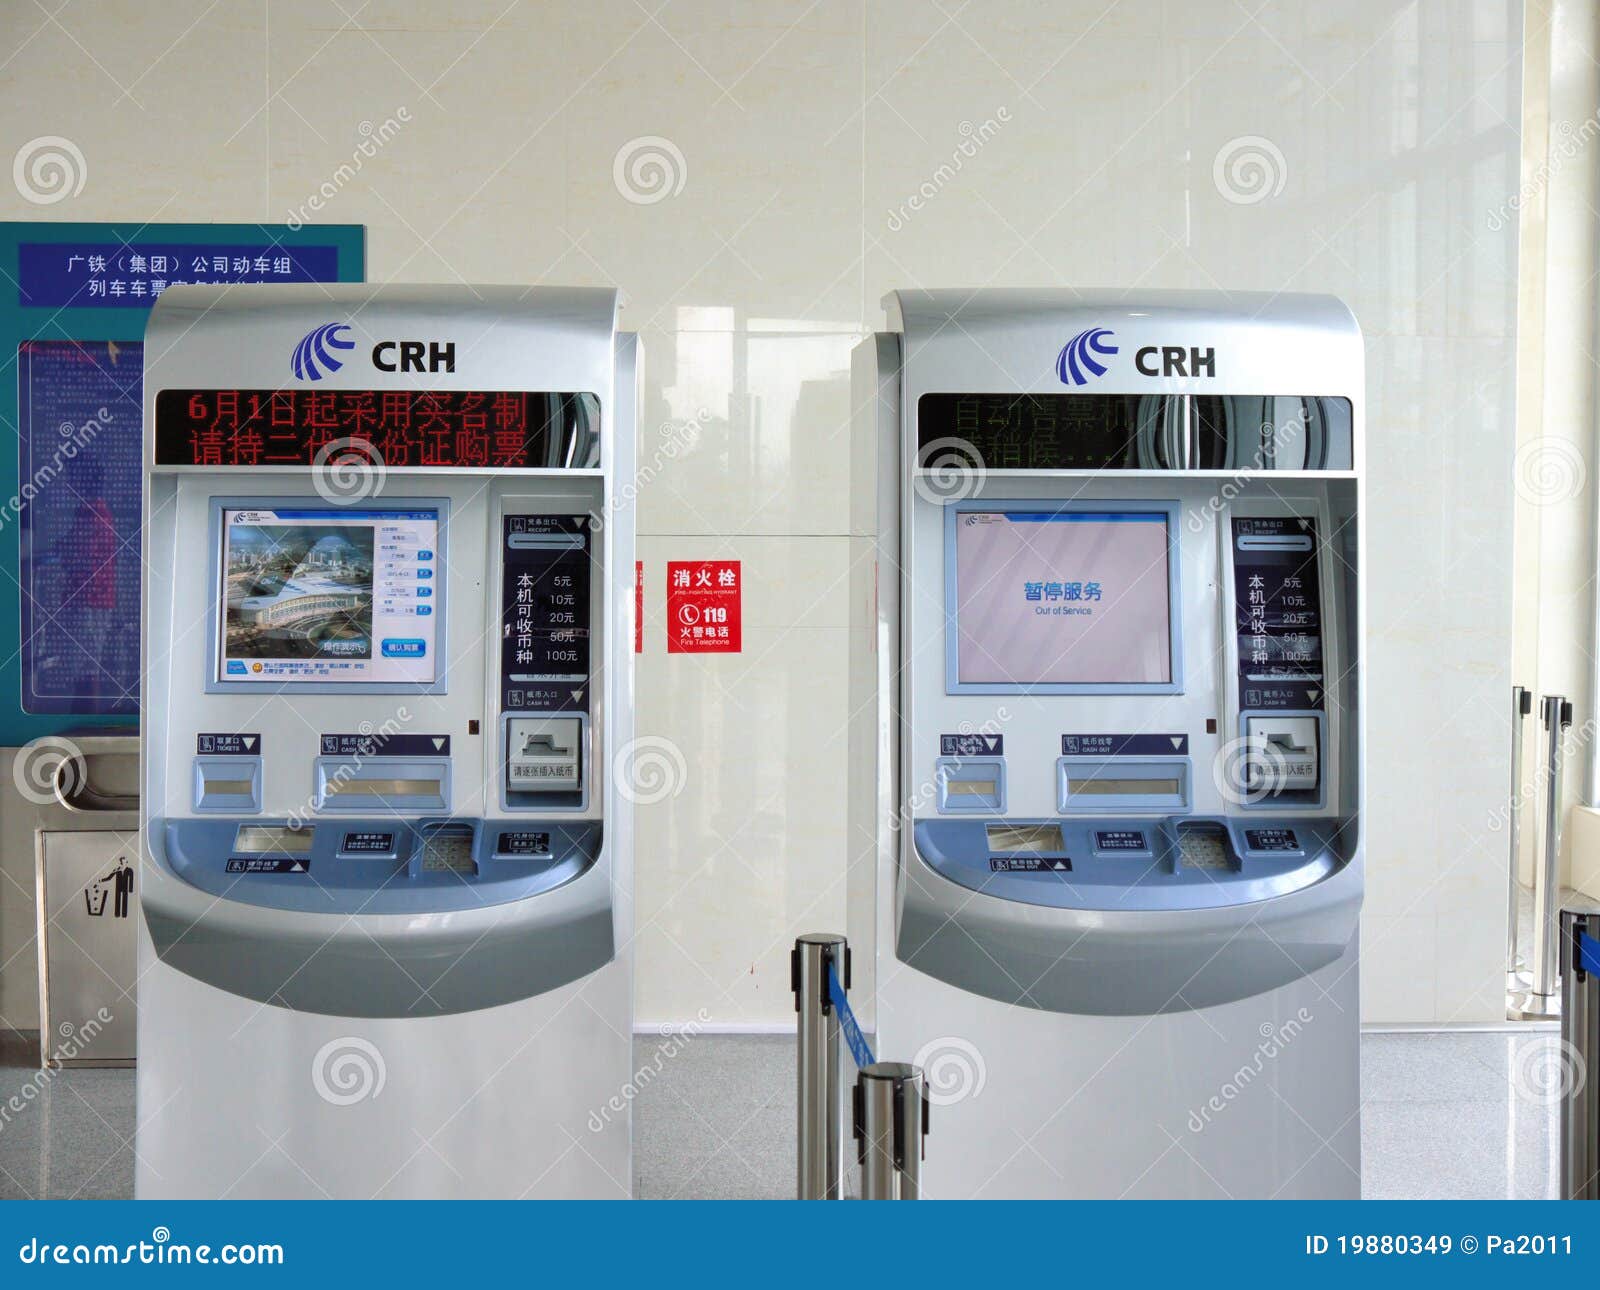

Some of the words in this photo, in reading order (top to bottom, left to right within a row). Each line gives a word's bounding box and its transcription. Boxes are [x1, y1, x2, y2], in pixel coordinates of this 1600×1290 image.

[371, 341, 456, 373] CRH
[1135, 346, 1216, 378] CRH
[188, 390, 527, 429] 6月1日起采用实名制
[189, 429, 528, 466] 请持二代身份证购票
[553, 576, 572, 587] 5元
[673, 569, 736, 587] 消火栓
[1283, 577, 1302, 588] 5元
[1024, 581, 1102, 601] 暂停服务
[551, 594, 575, 605] 10元
[1281, 595, 1306, 606] 10元
[703, 607, 727, 623] 119
[1035, 606, 1051, 615] Out
[1053, 606, 1061, 615] of
[1062, 606, 1092, 615] Service
[516, 573, 534, 665] 本机可收币种
[550, 612, 575, 623] 20元
[1249, 574, 1268, 665] 本机可收币种
[1282, 613, 1307, 624] 20元
[550, 631, 576, 642] 50元
[680, 626, 729, 638] 火警电话
[1283, 632, 1308, 643] 50元
[546, 650, 578, 662] 100元
[1281, 650, 1311, 662] 100元
